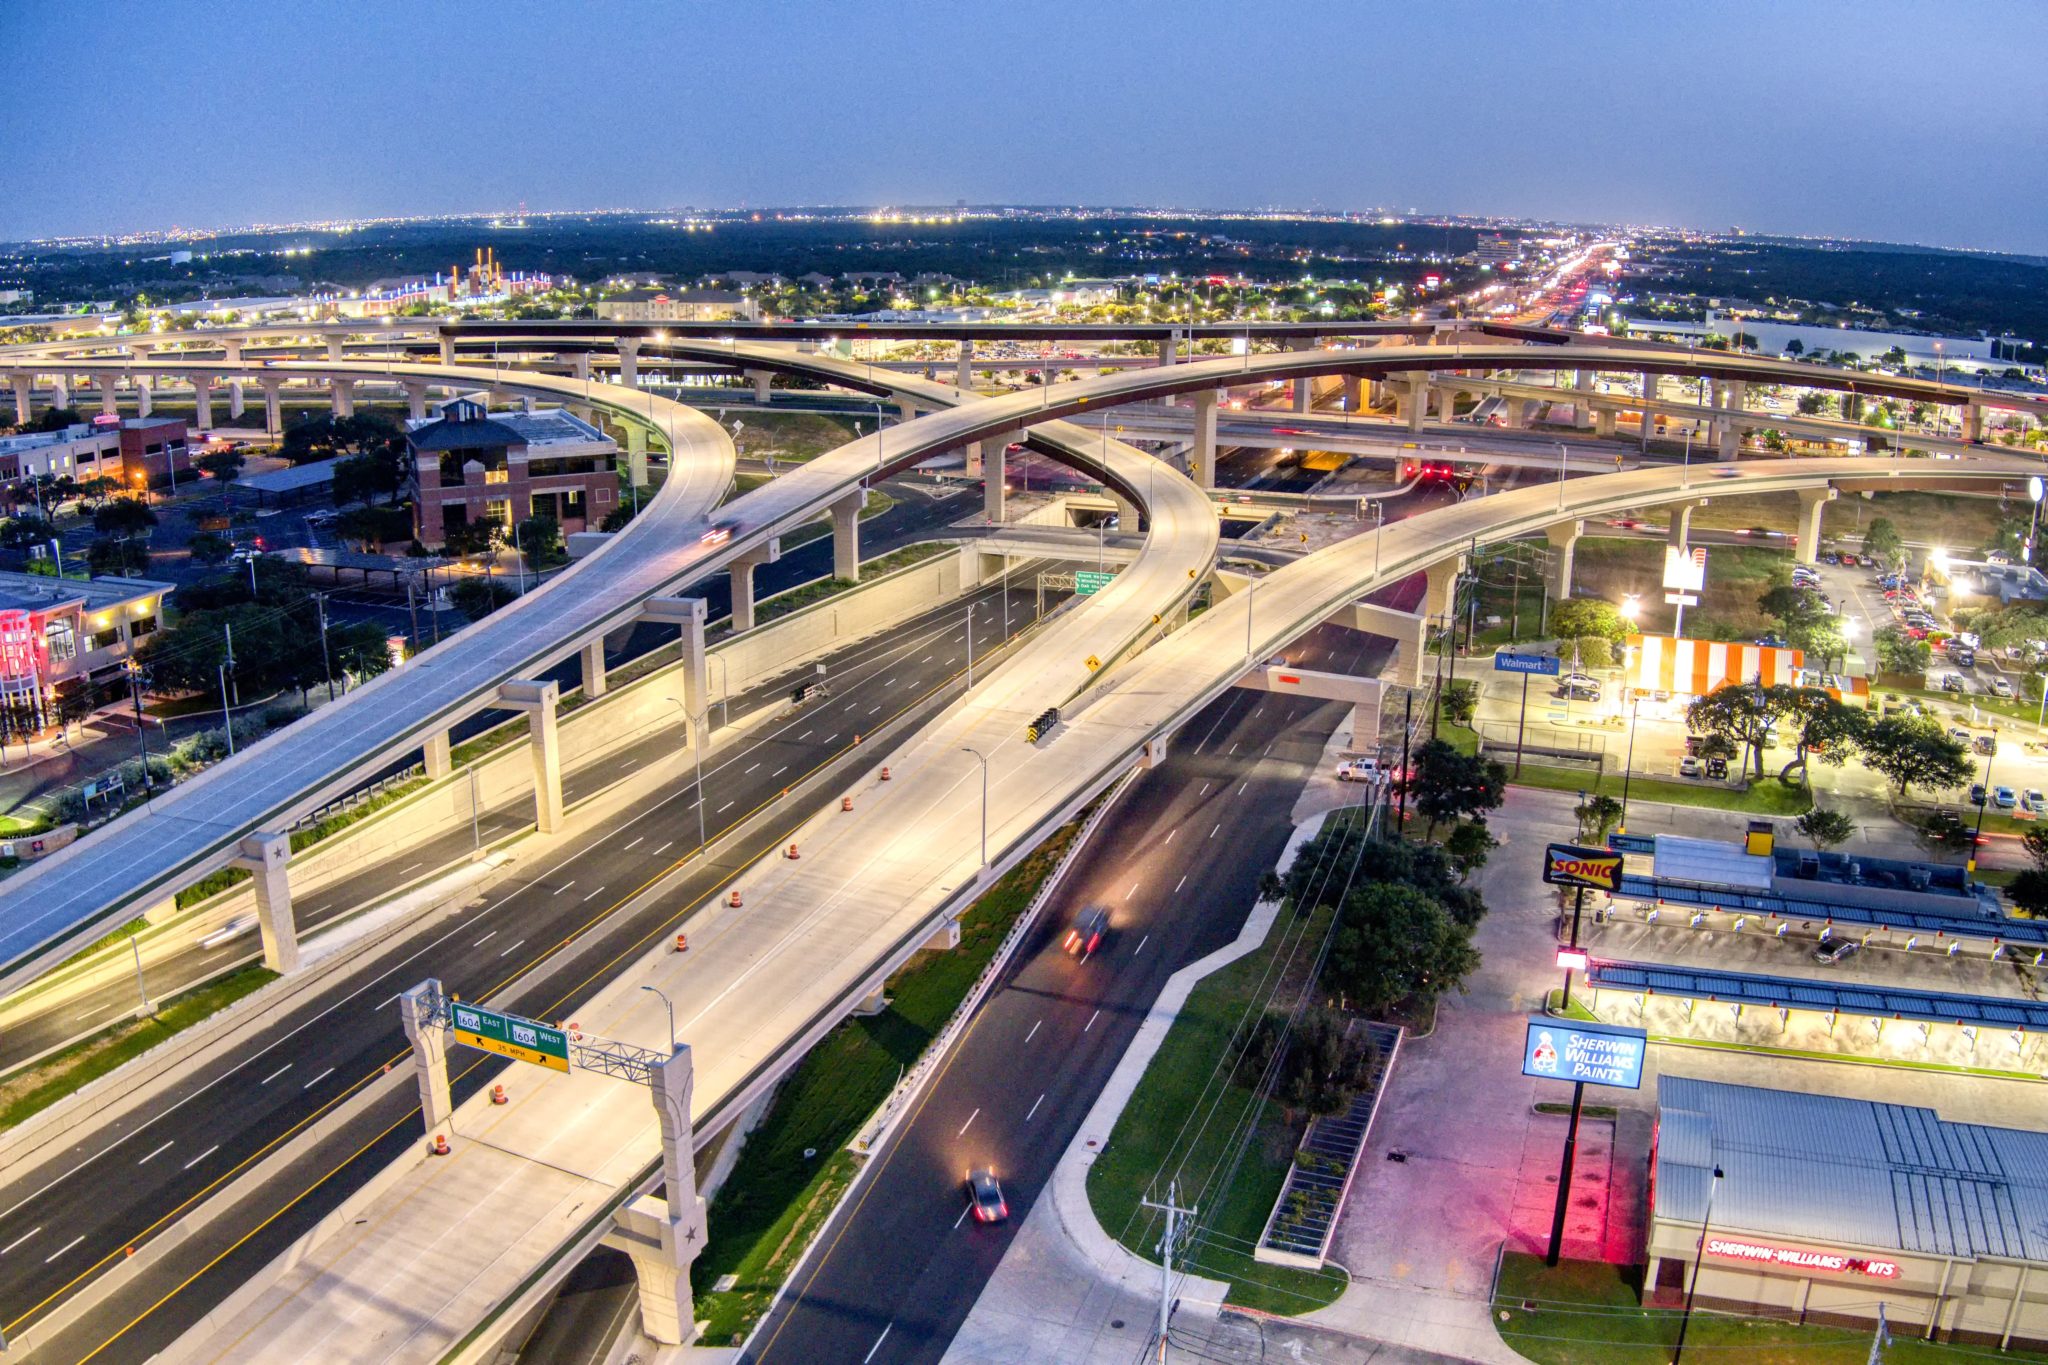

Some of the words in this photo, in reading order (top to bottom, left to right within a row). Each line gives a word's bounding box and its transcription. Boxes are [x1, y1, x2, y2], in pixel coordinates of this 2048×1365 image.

[1501, 657, 1542, 670] Walmart
[1554, 859, 1614, 879] SONIC
[458, 1015, 480, 1029] 1604
[482, 1016, 501, 1028] EAST
[513, 1030, 536, 1045] 1604
[540, 1031, 561, 1045] WEST
[1567, 1034, 1637, 1056] SHERWIN
[510, 1047, 526, 1057] MPH
[1564, 1047, 1636, 1070] WILLIAMS
[1572, 1062, 1625, 1082] PAINTS
[1707, 1240, 1843, 1269] SHERWIN-WILLIAMS
